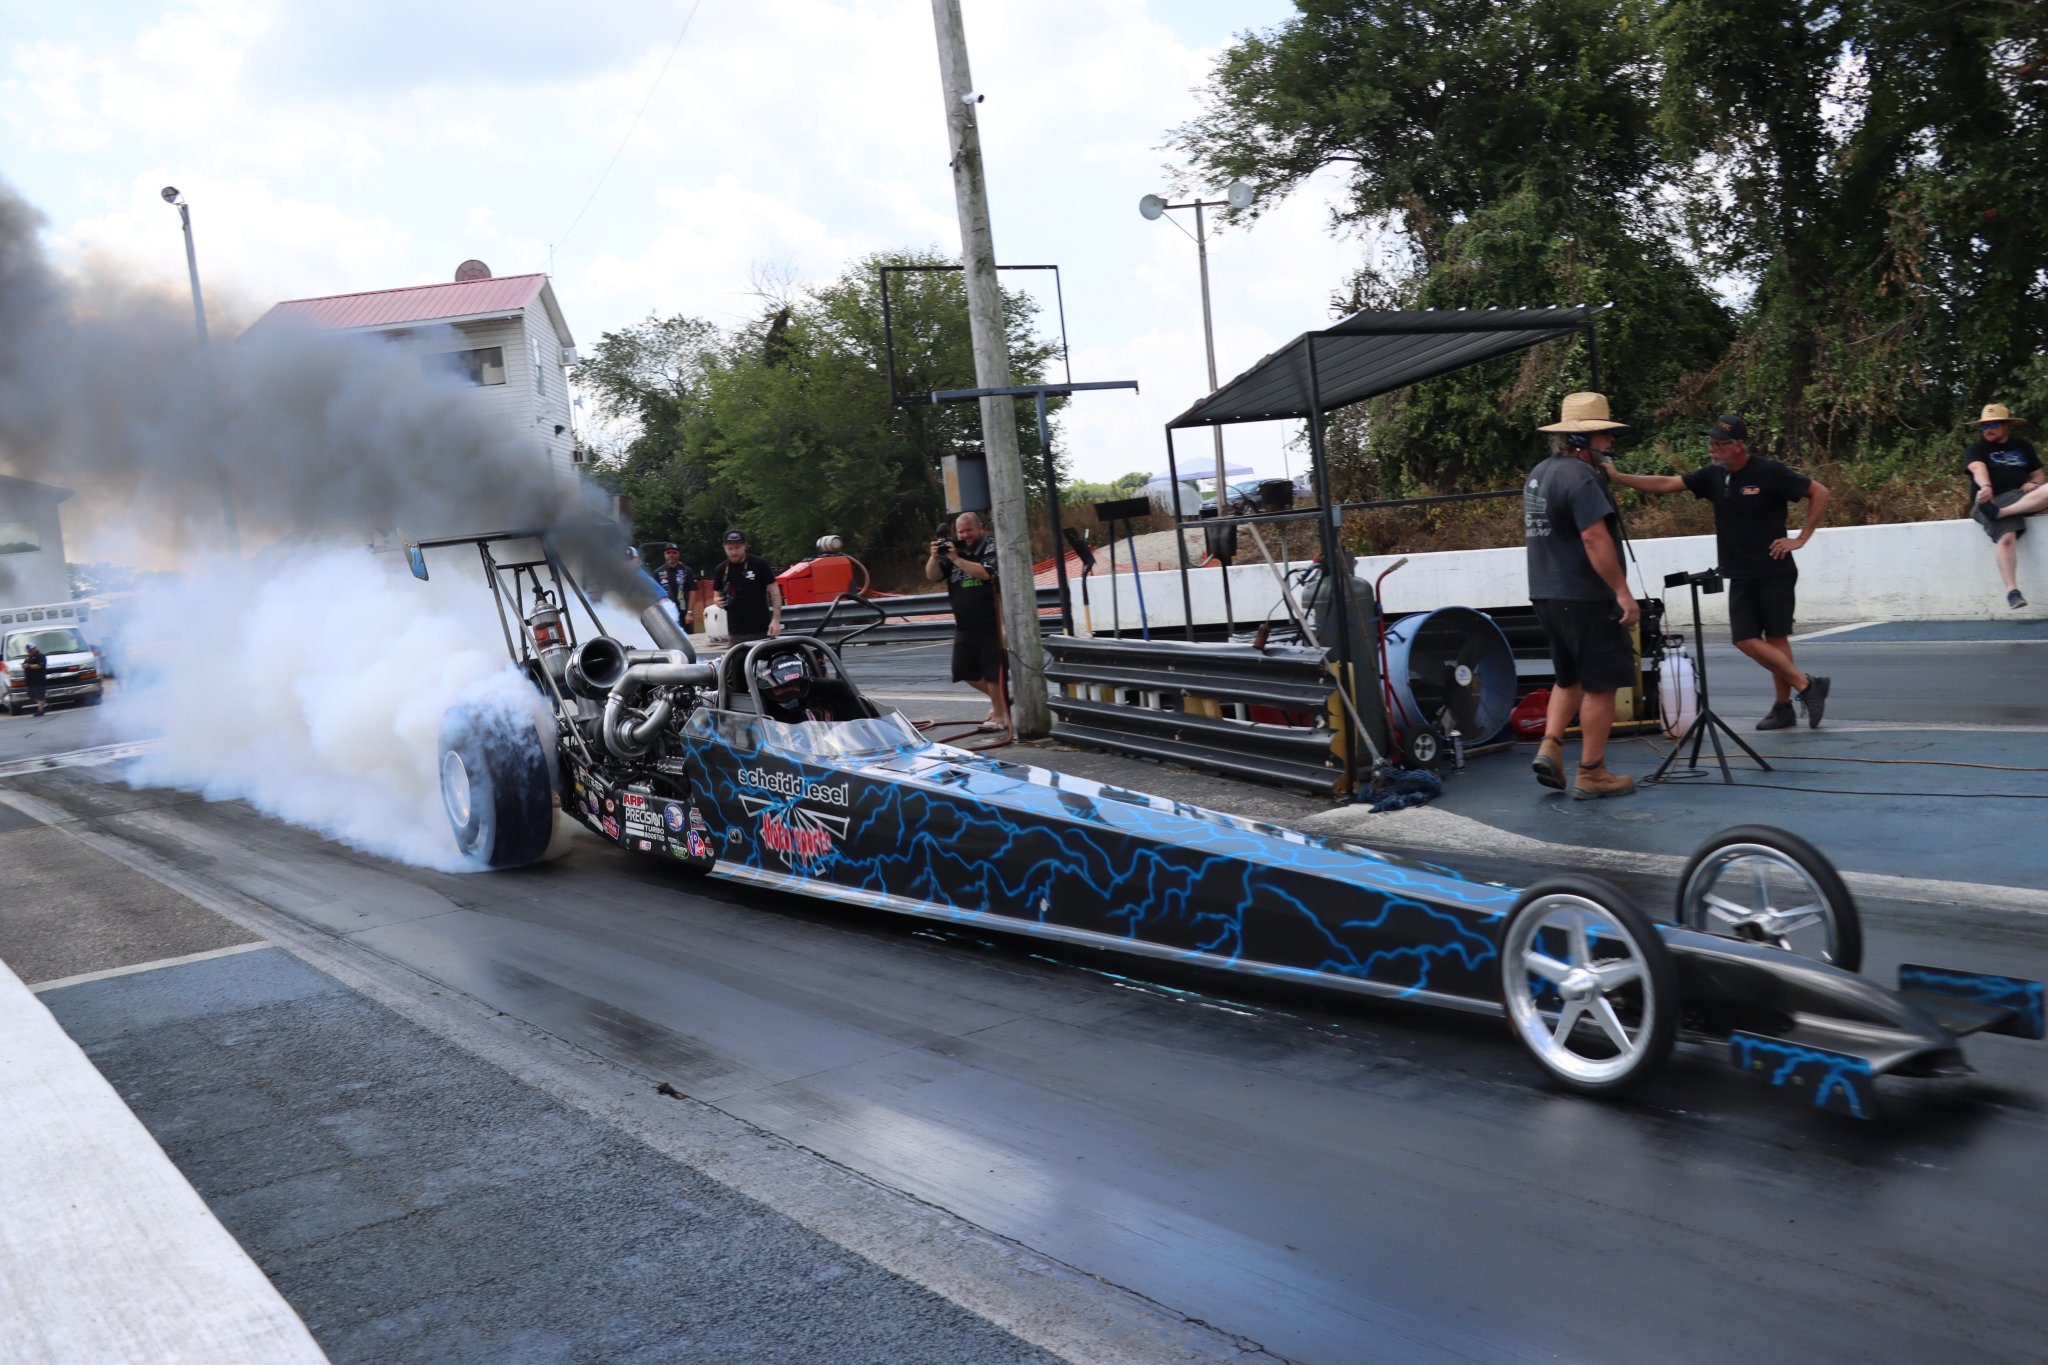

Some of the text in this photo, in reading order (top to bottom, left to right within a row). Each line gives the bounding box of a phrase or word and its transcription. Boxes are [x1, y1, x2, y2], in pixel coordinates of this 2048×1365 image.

[738, 768, 849, 807] scheiddiesel
[623, 793, 646, 810] ARP
[645, 824, 665, 835] TURBO
